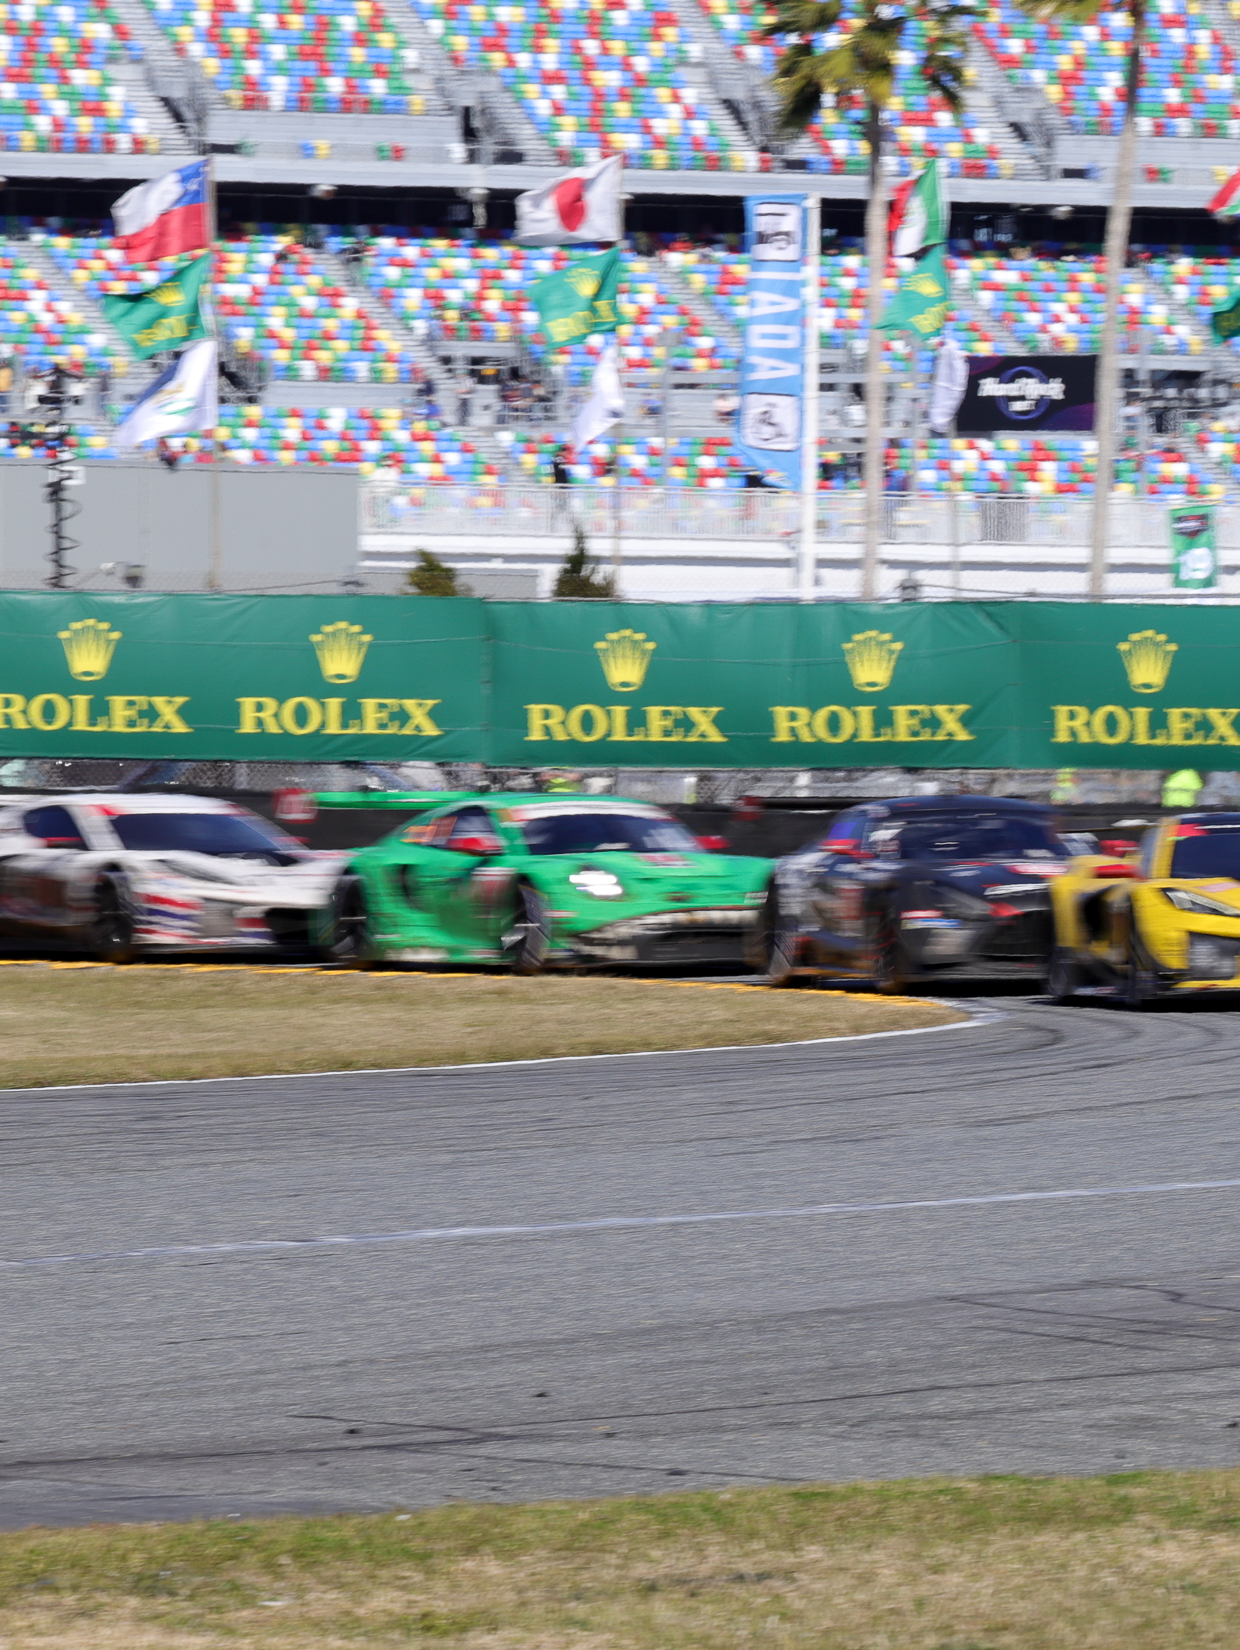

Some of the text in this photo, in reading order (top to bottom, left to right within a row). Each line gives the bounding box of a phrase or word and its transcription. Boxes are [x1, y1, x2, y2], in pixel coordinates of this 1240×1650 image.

[0, 693, 193, 733] ROLEX
[237, 697, 443, 737] ROLEX
[525, 704, 728, 743] ROLEX
[771, 704, 975, 743] ROLEX
